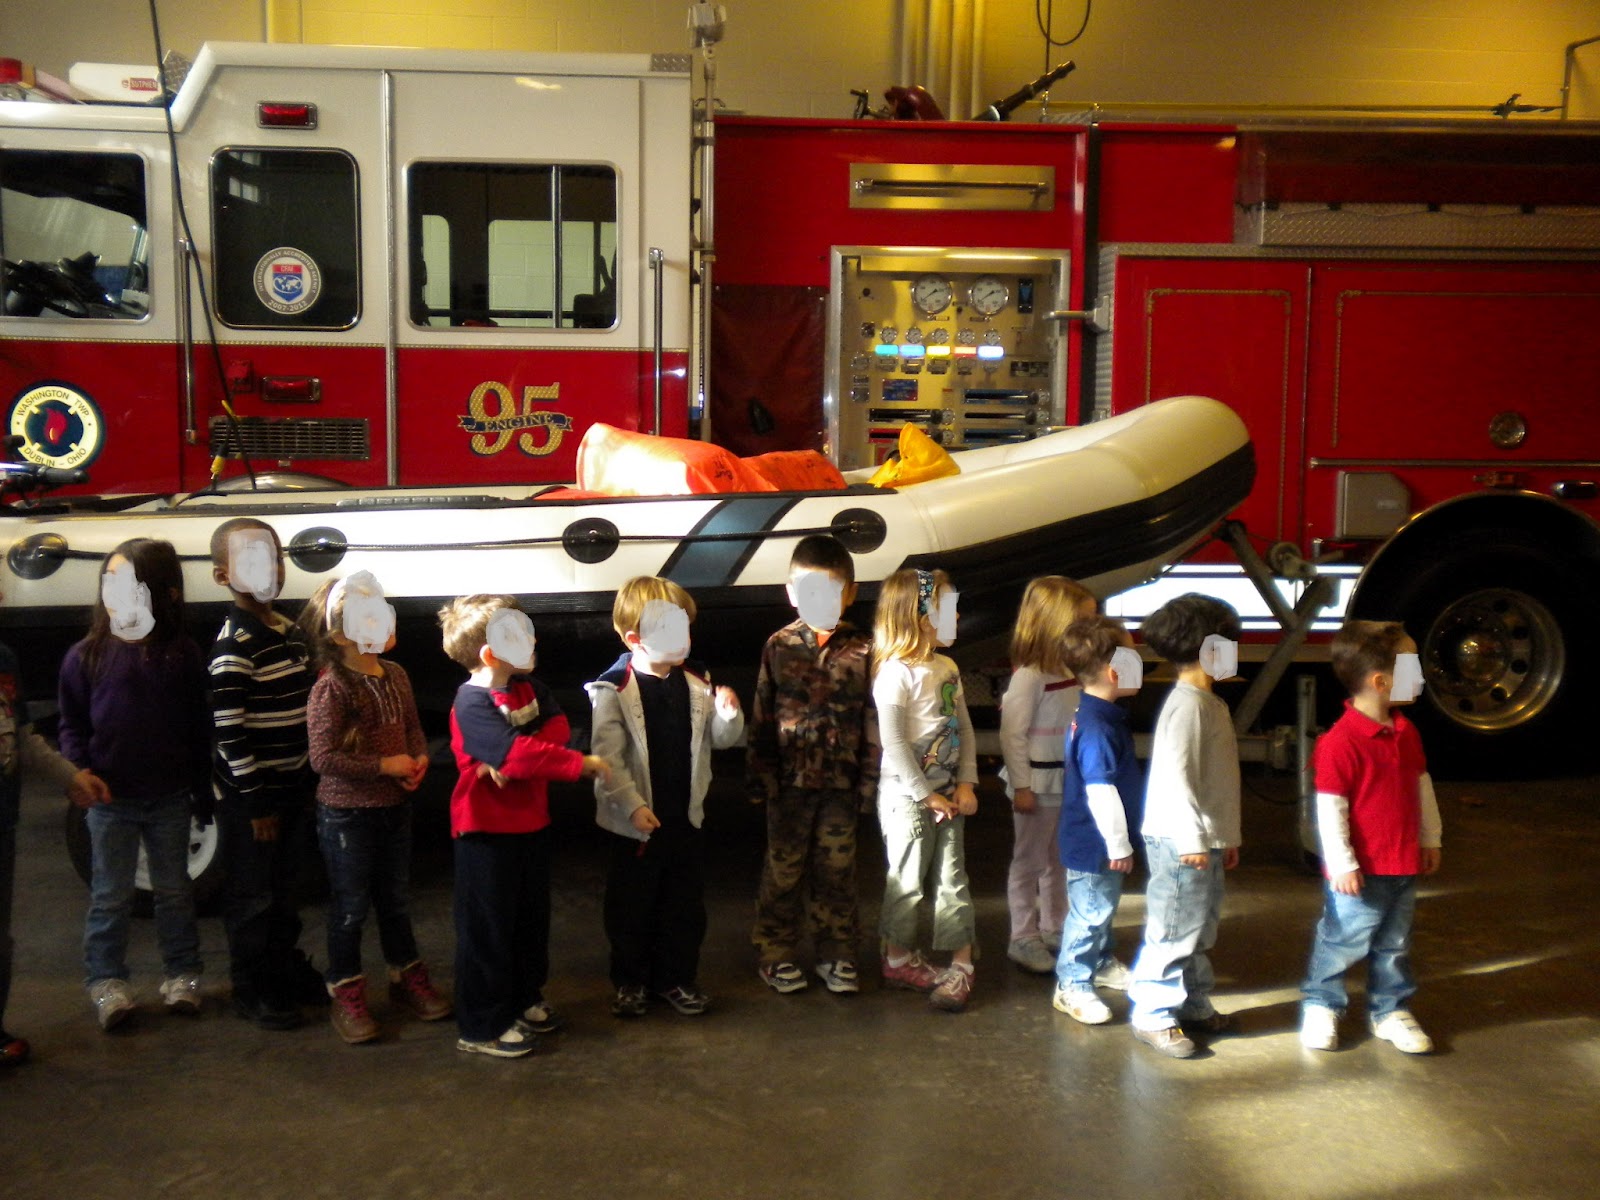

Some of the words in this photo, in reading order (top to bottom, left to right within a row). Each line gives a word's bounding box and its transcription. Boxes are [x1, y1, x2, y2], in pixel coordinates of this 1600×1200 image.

[268, 300, 308, 311] 2007-2012
[17, 390, 70, 416] WASHINGTON
[468, 381, 563, 456] 95
[484, 413, 554, 431] ENGINE
[24, 447, 55, 467] DUBLIN
[67, 447, 87, 464] OHIO
